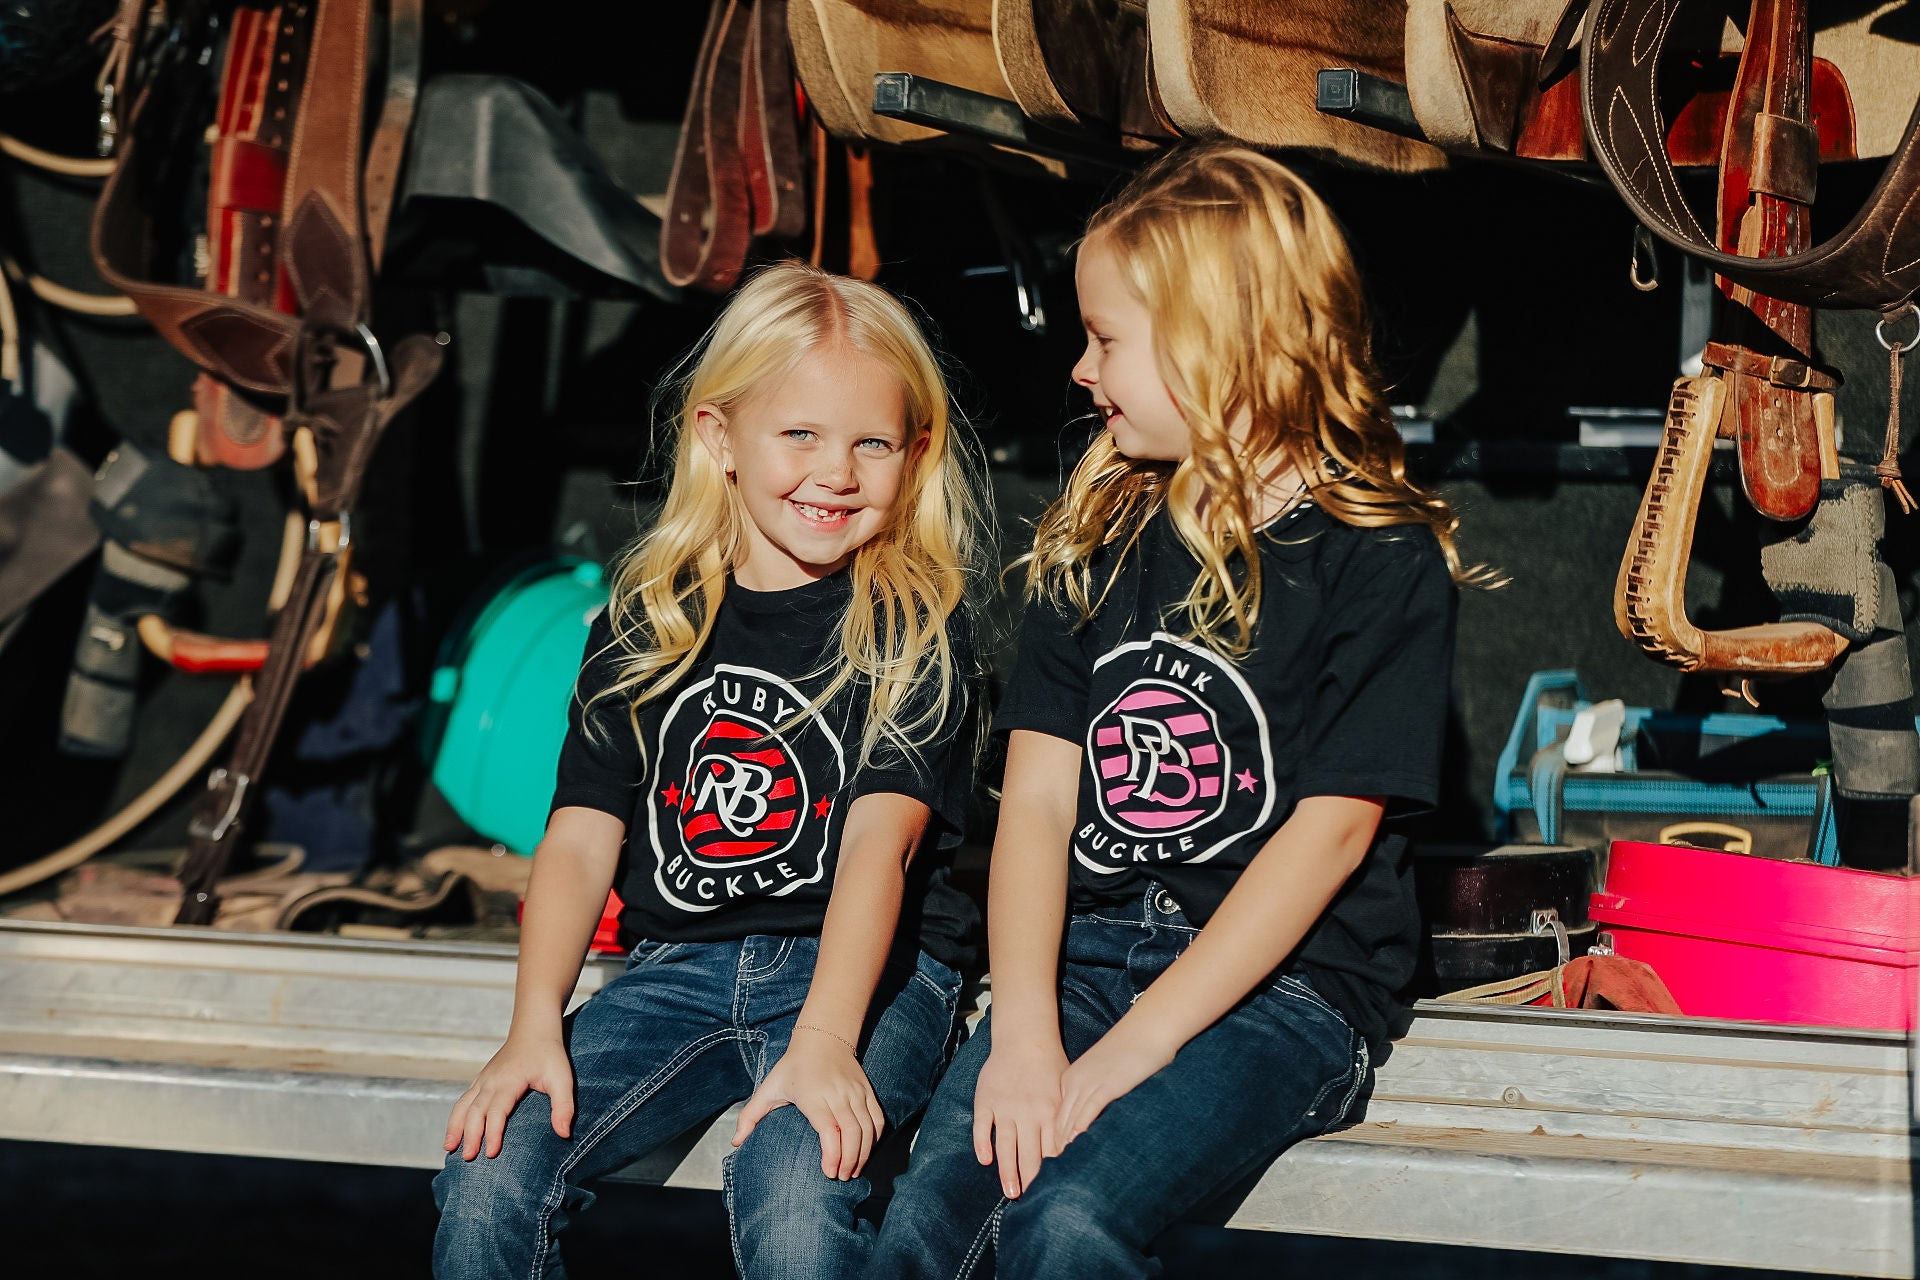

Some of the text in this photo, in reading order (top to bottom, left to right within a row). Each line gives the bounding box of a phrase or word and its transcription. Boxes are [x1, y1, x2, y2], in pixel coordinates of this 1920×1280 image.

[1142, 653, 1213, 693] INK
[703, 680, 795, 724] RUBY
[691, 754, 772, 837] RB
[1079, 822, 1195, 862] BUCKLE
[667, 854, 797, 899] BUCKLE
